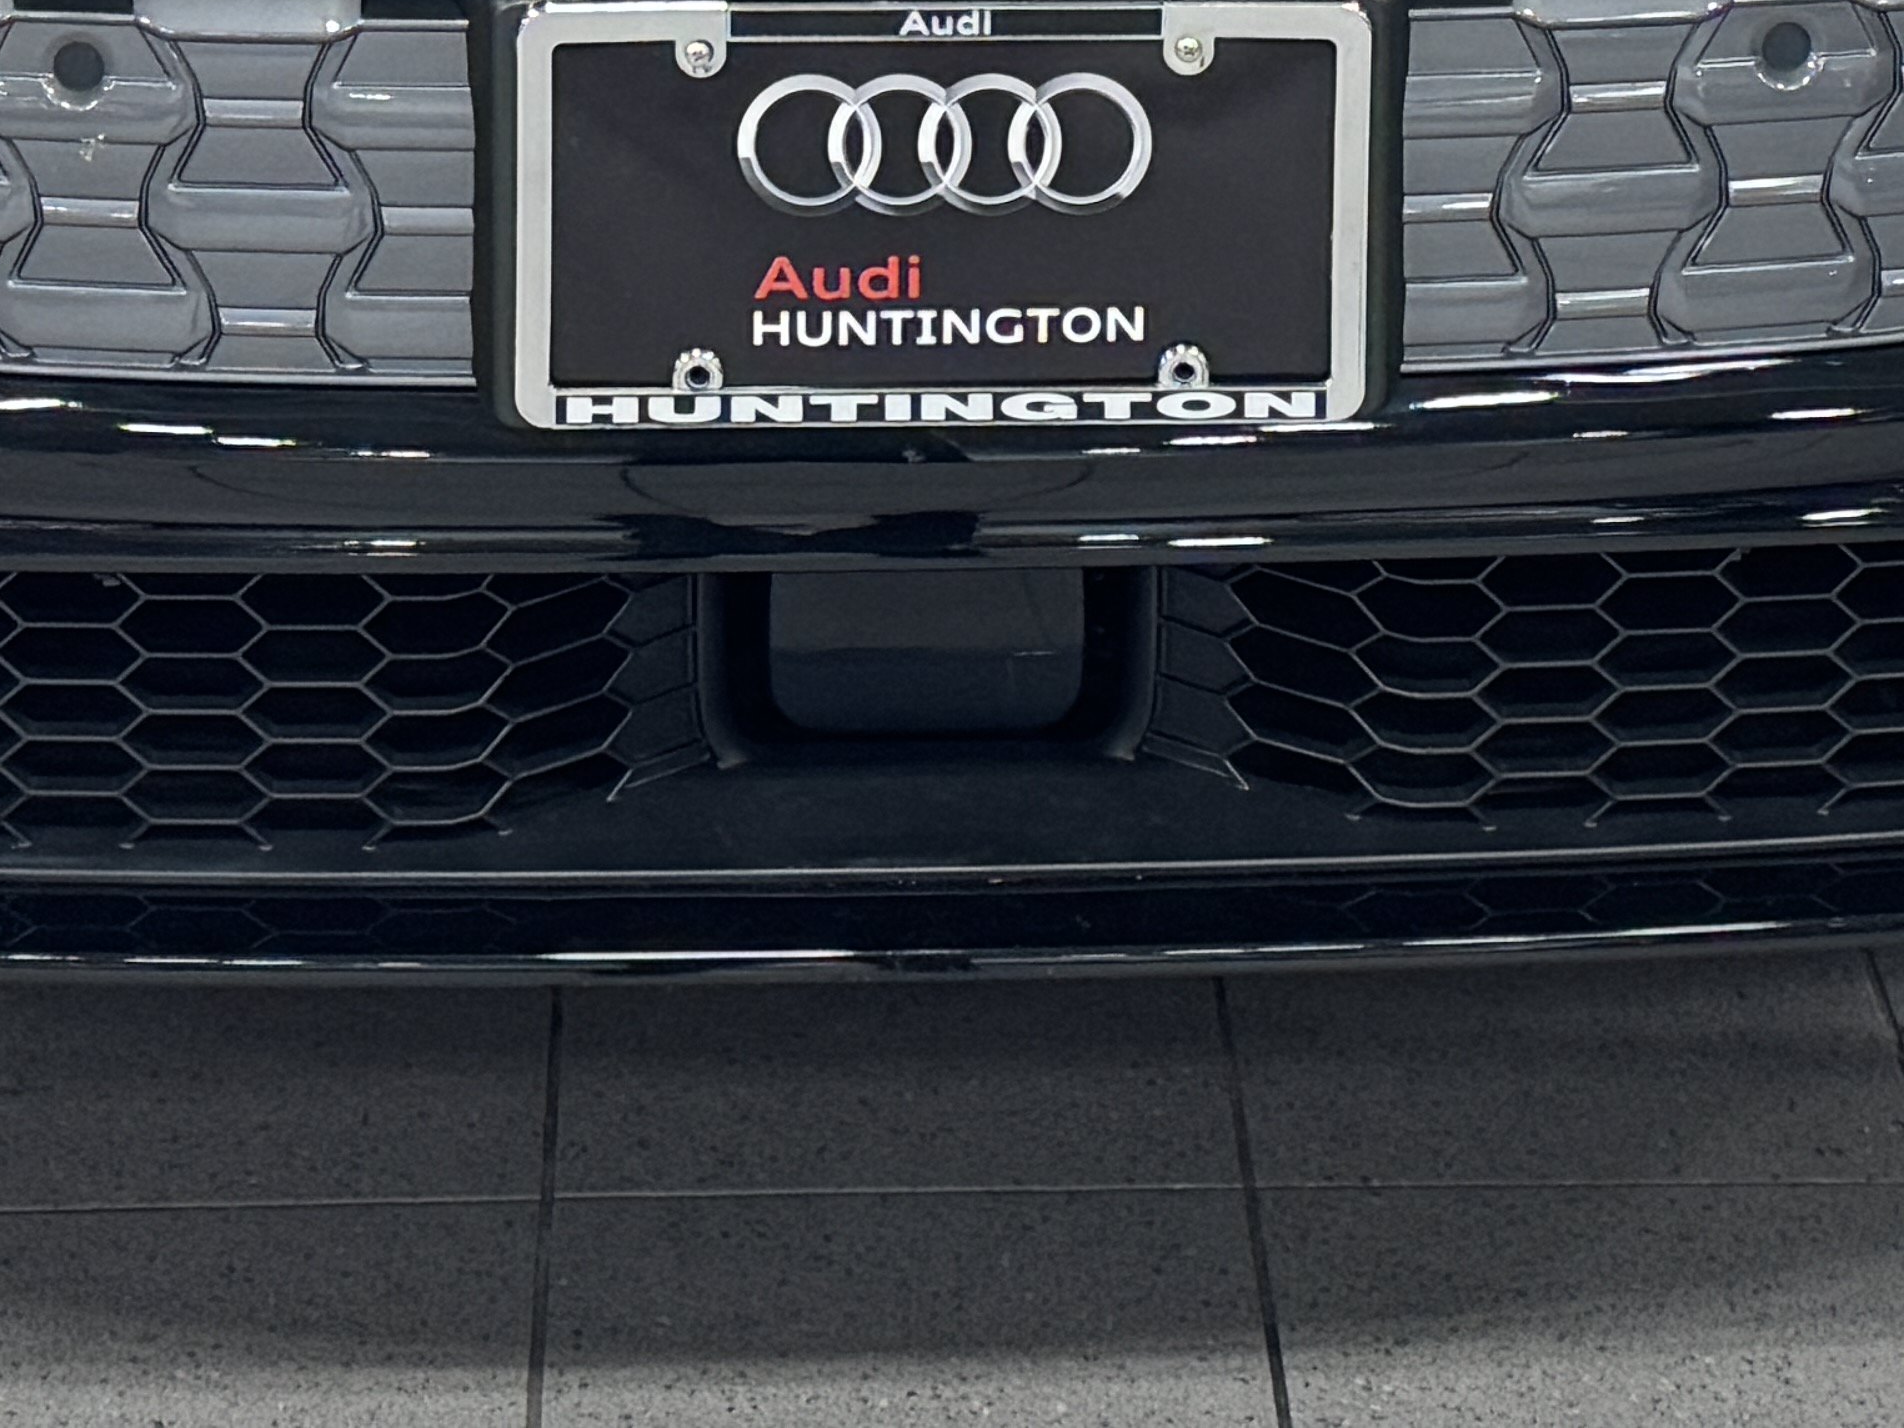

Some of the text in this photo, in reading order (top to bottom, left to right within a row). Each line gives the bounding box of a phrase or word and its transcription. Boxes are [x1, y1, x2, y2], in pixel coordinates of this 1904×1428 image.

[899, 9, 993, 36] Audi
[754, 256, 922, 301] Audi
[752, 305, 1146, 347] HUNTINGTON
[564, 391, 1317, 425] HUNTINGTON
